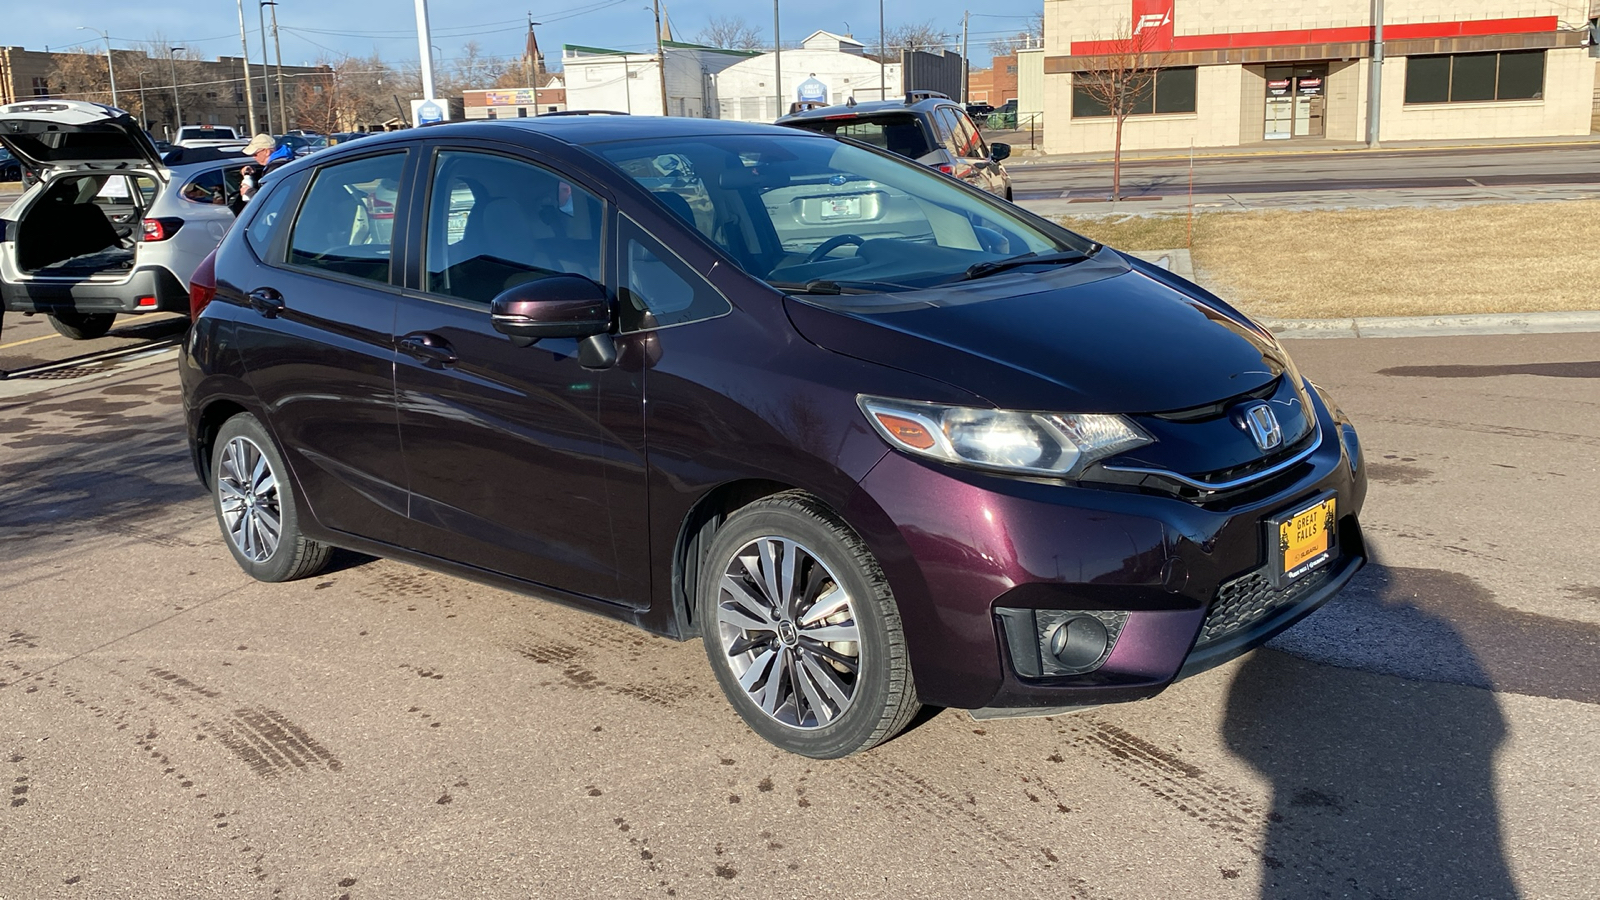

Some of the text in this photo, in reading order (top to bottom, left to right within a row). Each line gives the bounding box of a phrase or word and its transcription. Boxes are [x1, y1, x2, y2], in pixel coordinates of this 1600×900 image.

[1297, 512, 1317, 530] GREAT
[1297, 524, 1317, 542] FALLS
[1300, 545, 1319, 558] SUBARU
